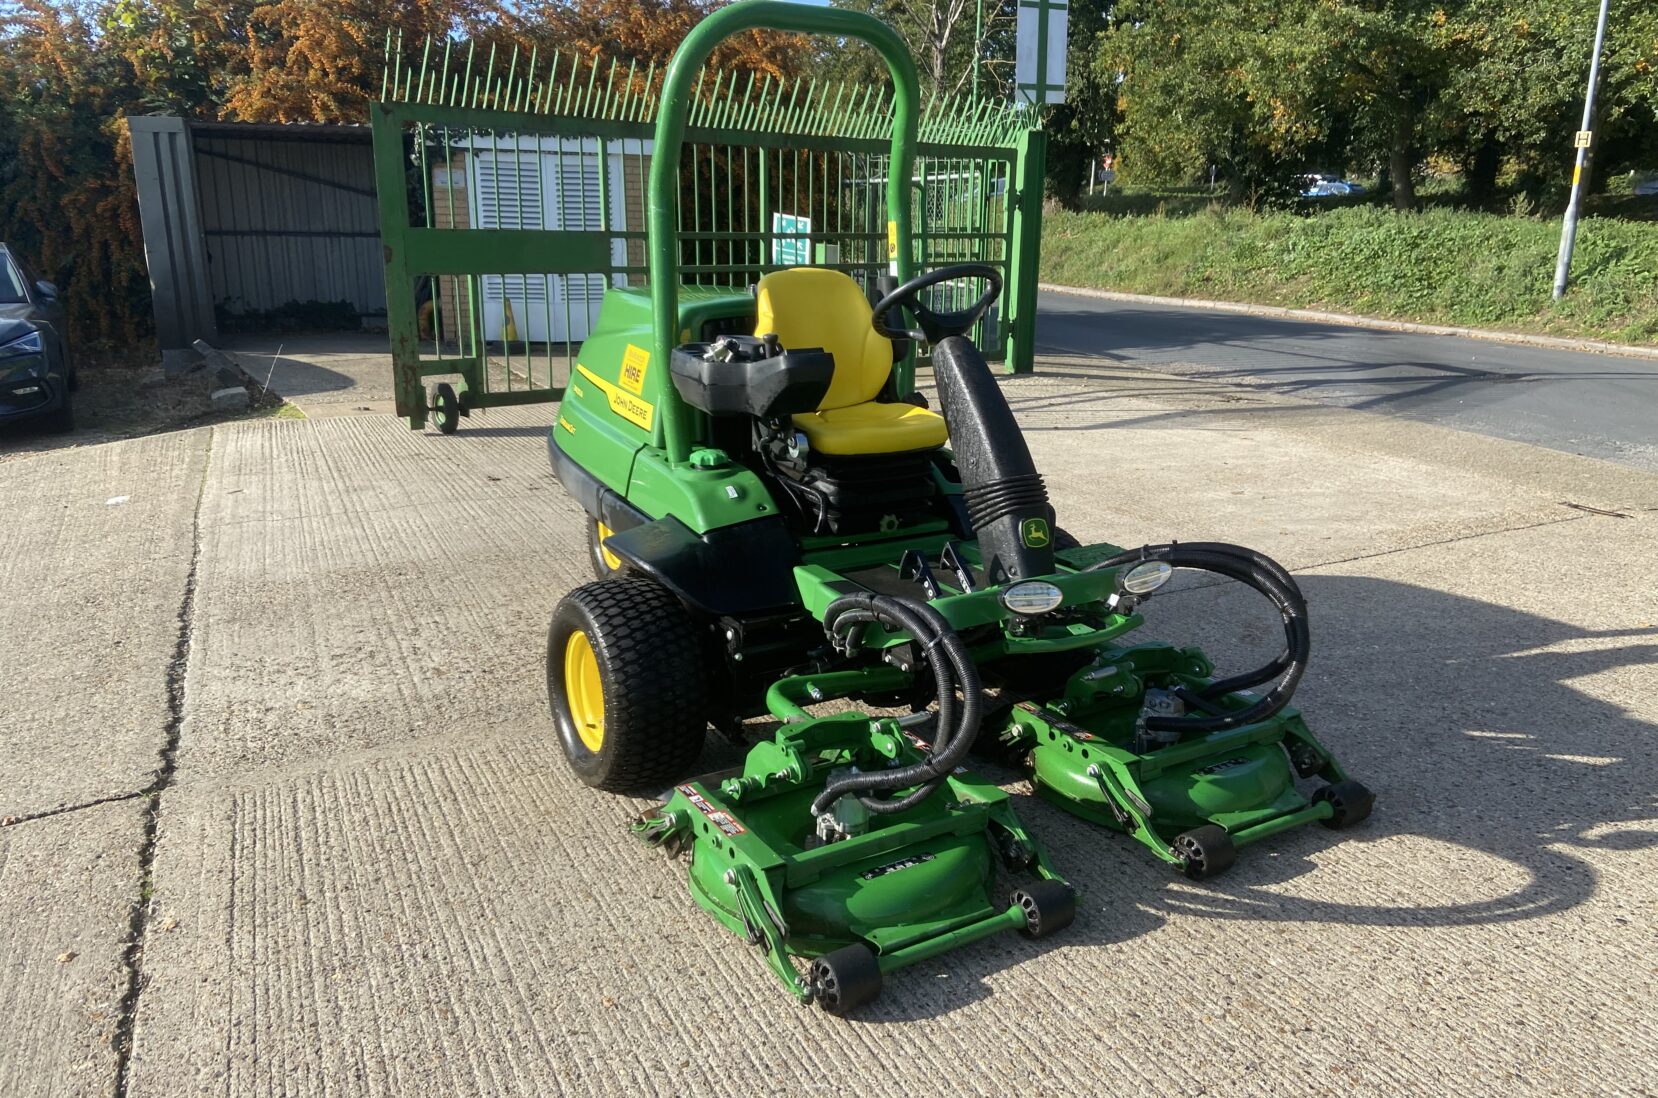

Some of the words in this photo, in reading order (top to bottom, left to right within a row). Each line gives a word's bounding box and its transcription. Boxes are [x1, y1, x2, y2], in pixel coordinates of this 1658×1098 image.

[624, 364, 641, 383] HIRE
[613, 393, 628, 410] JOHN
[628, 400, 648, 420] DEERE
